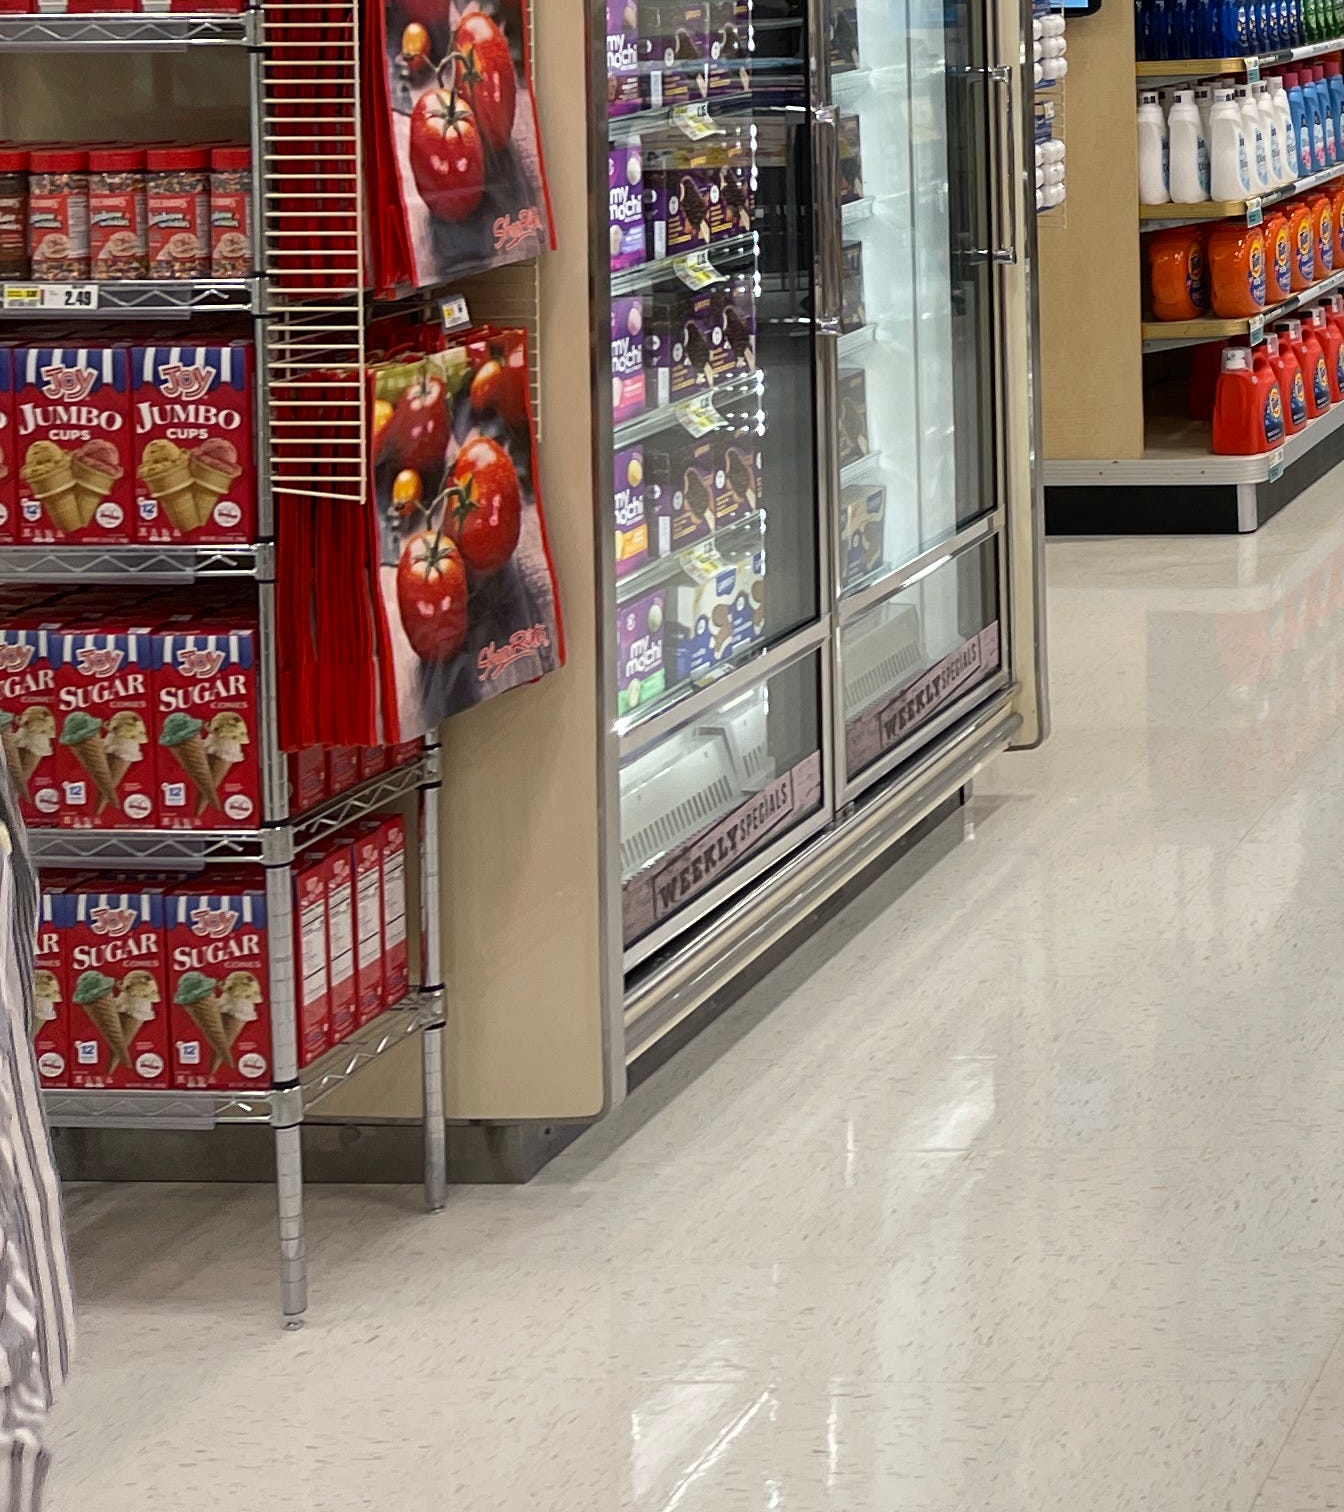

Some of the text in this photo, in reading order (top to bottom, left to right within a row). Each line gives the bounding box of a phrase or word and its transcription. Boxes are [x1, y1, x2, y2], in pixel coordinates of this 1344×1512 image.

[64, 291, 91, 306] 2.49
[19, 402, 123, 435] JUMBO
[49, 429, 91, 441] CUPS
[136, 401, 242, 434] JUMBO
[166, 427, 209, 440] CUPS
[58, 674, 146, 711] SUGAR
[159, 675, 247, 712] SUGAR
[883, 642, 978, 740] WEEKLY SPECIALS
[658, 781, 788, 911] WEEKLY SPECIALS
[72, 933, 159, 970] SUGAR
[173, 934, 260, 971] SUGAR
